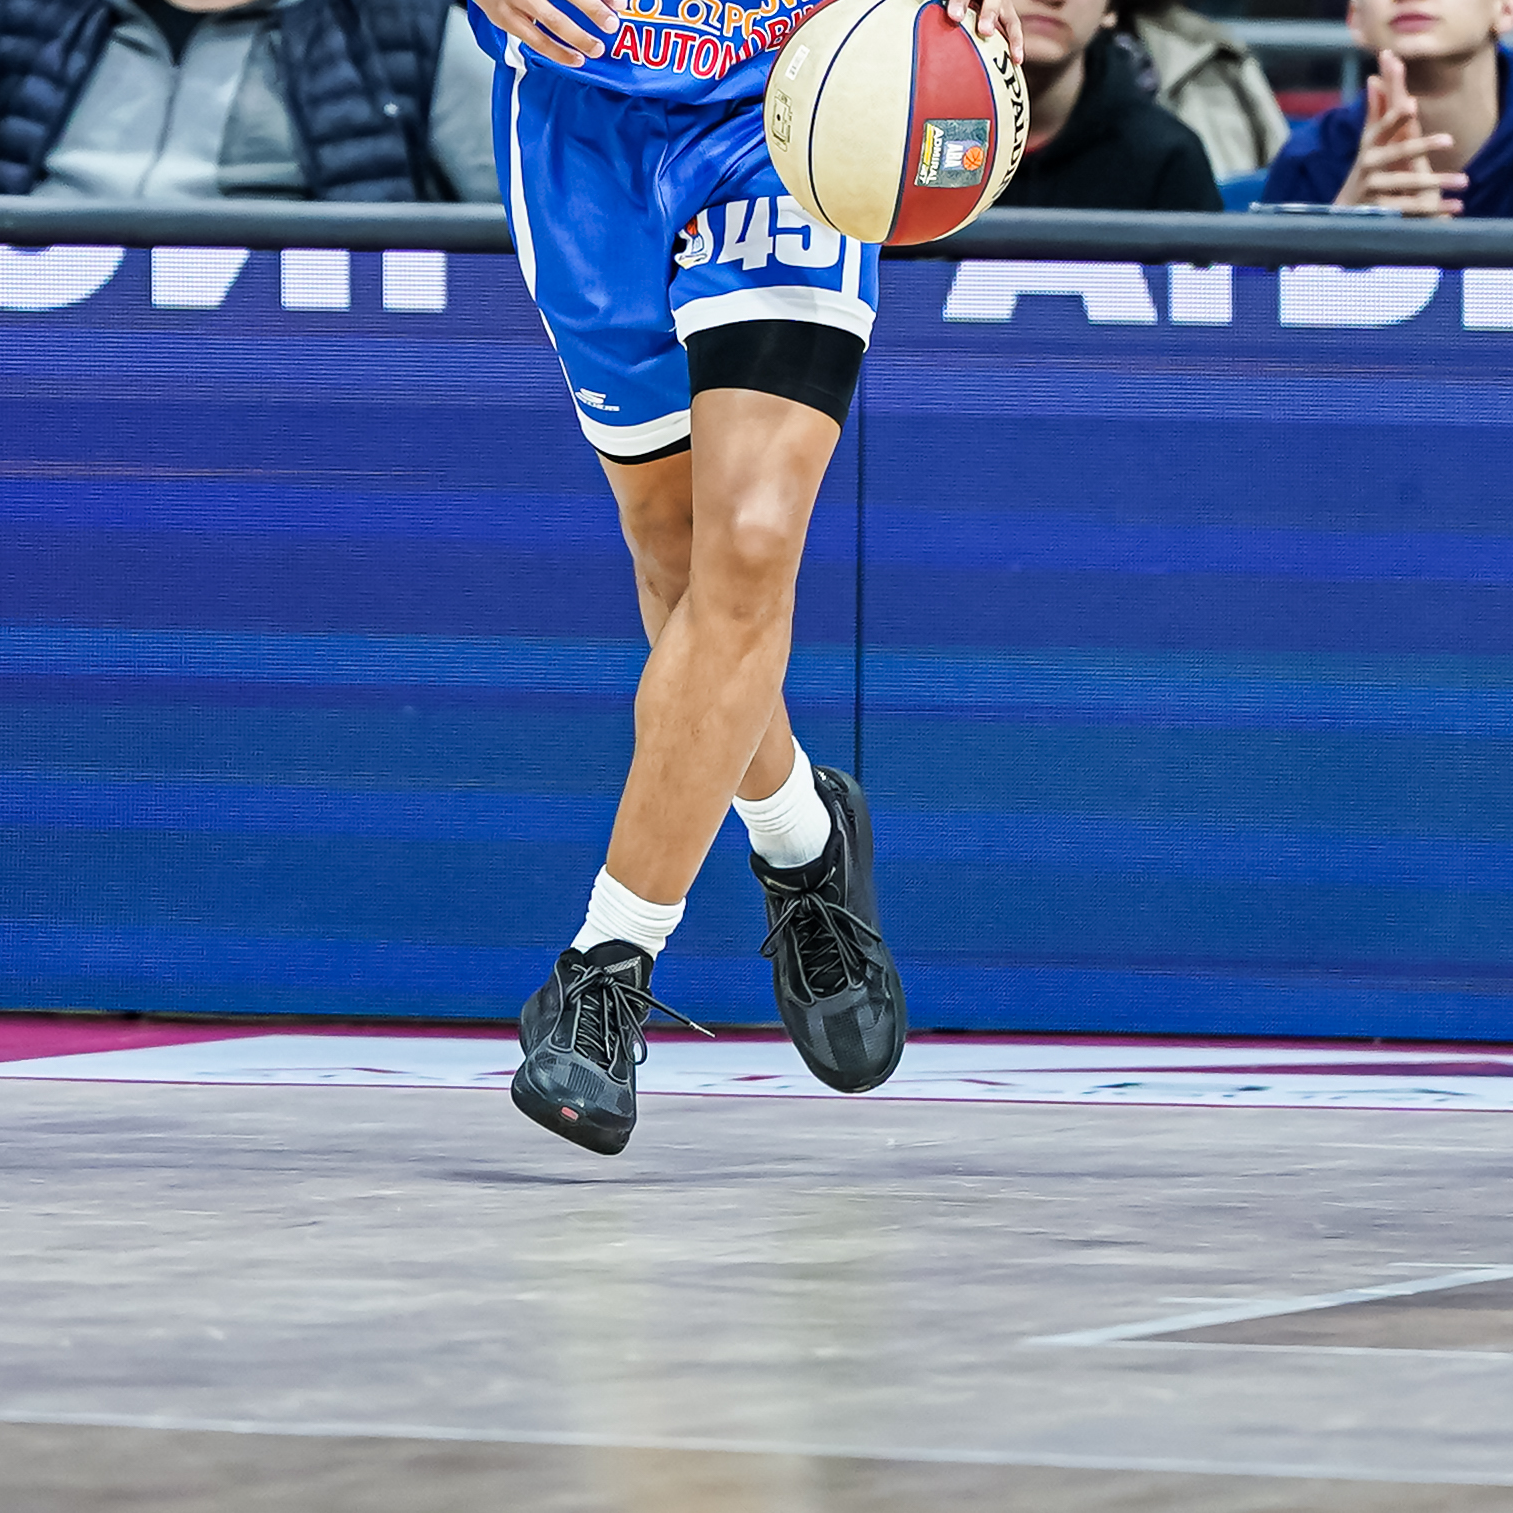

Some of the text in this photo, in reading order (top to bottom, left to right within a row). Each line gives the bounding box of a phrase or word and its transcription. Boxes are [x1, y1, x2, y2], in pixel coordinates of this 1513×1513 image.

[925, 126, 944, 185] ADMIRAL
[945, 143, 964, 169] ABA
[990, 50, 1027, 201] SPALDIN
[716, 195, 841, 271] 45
